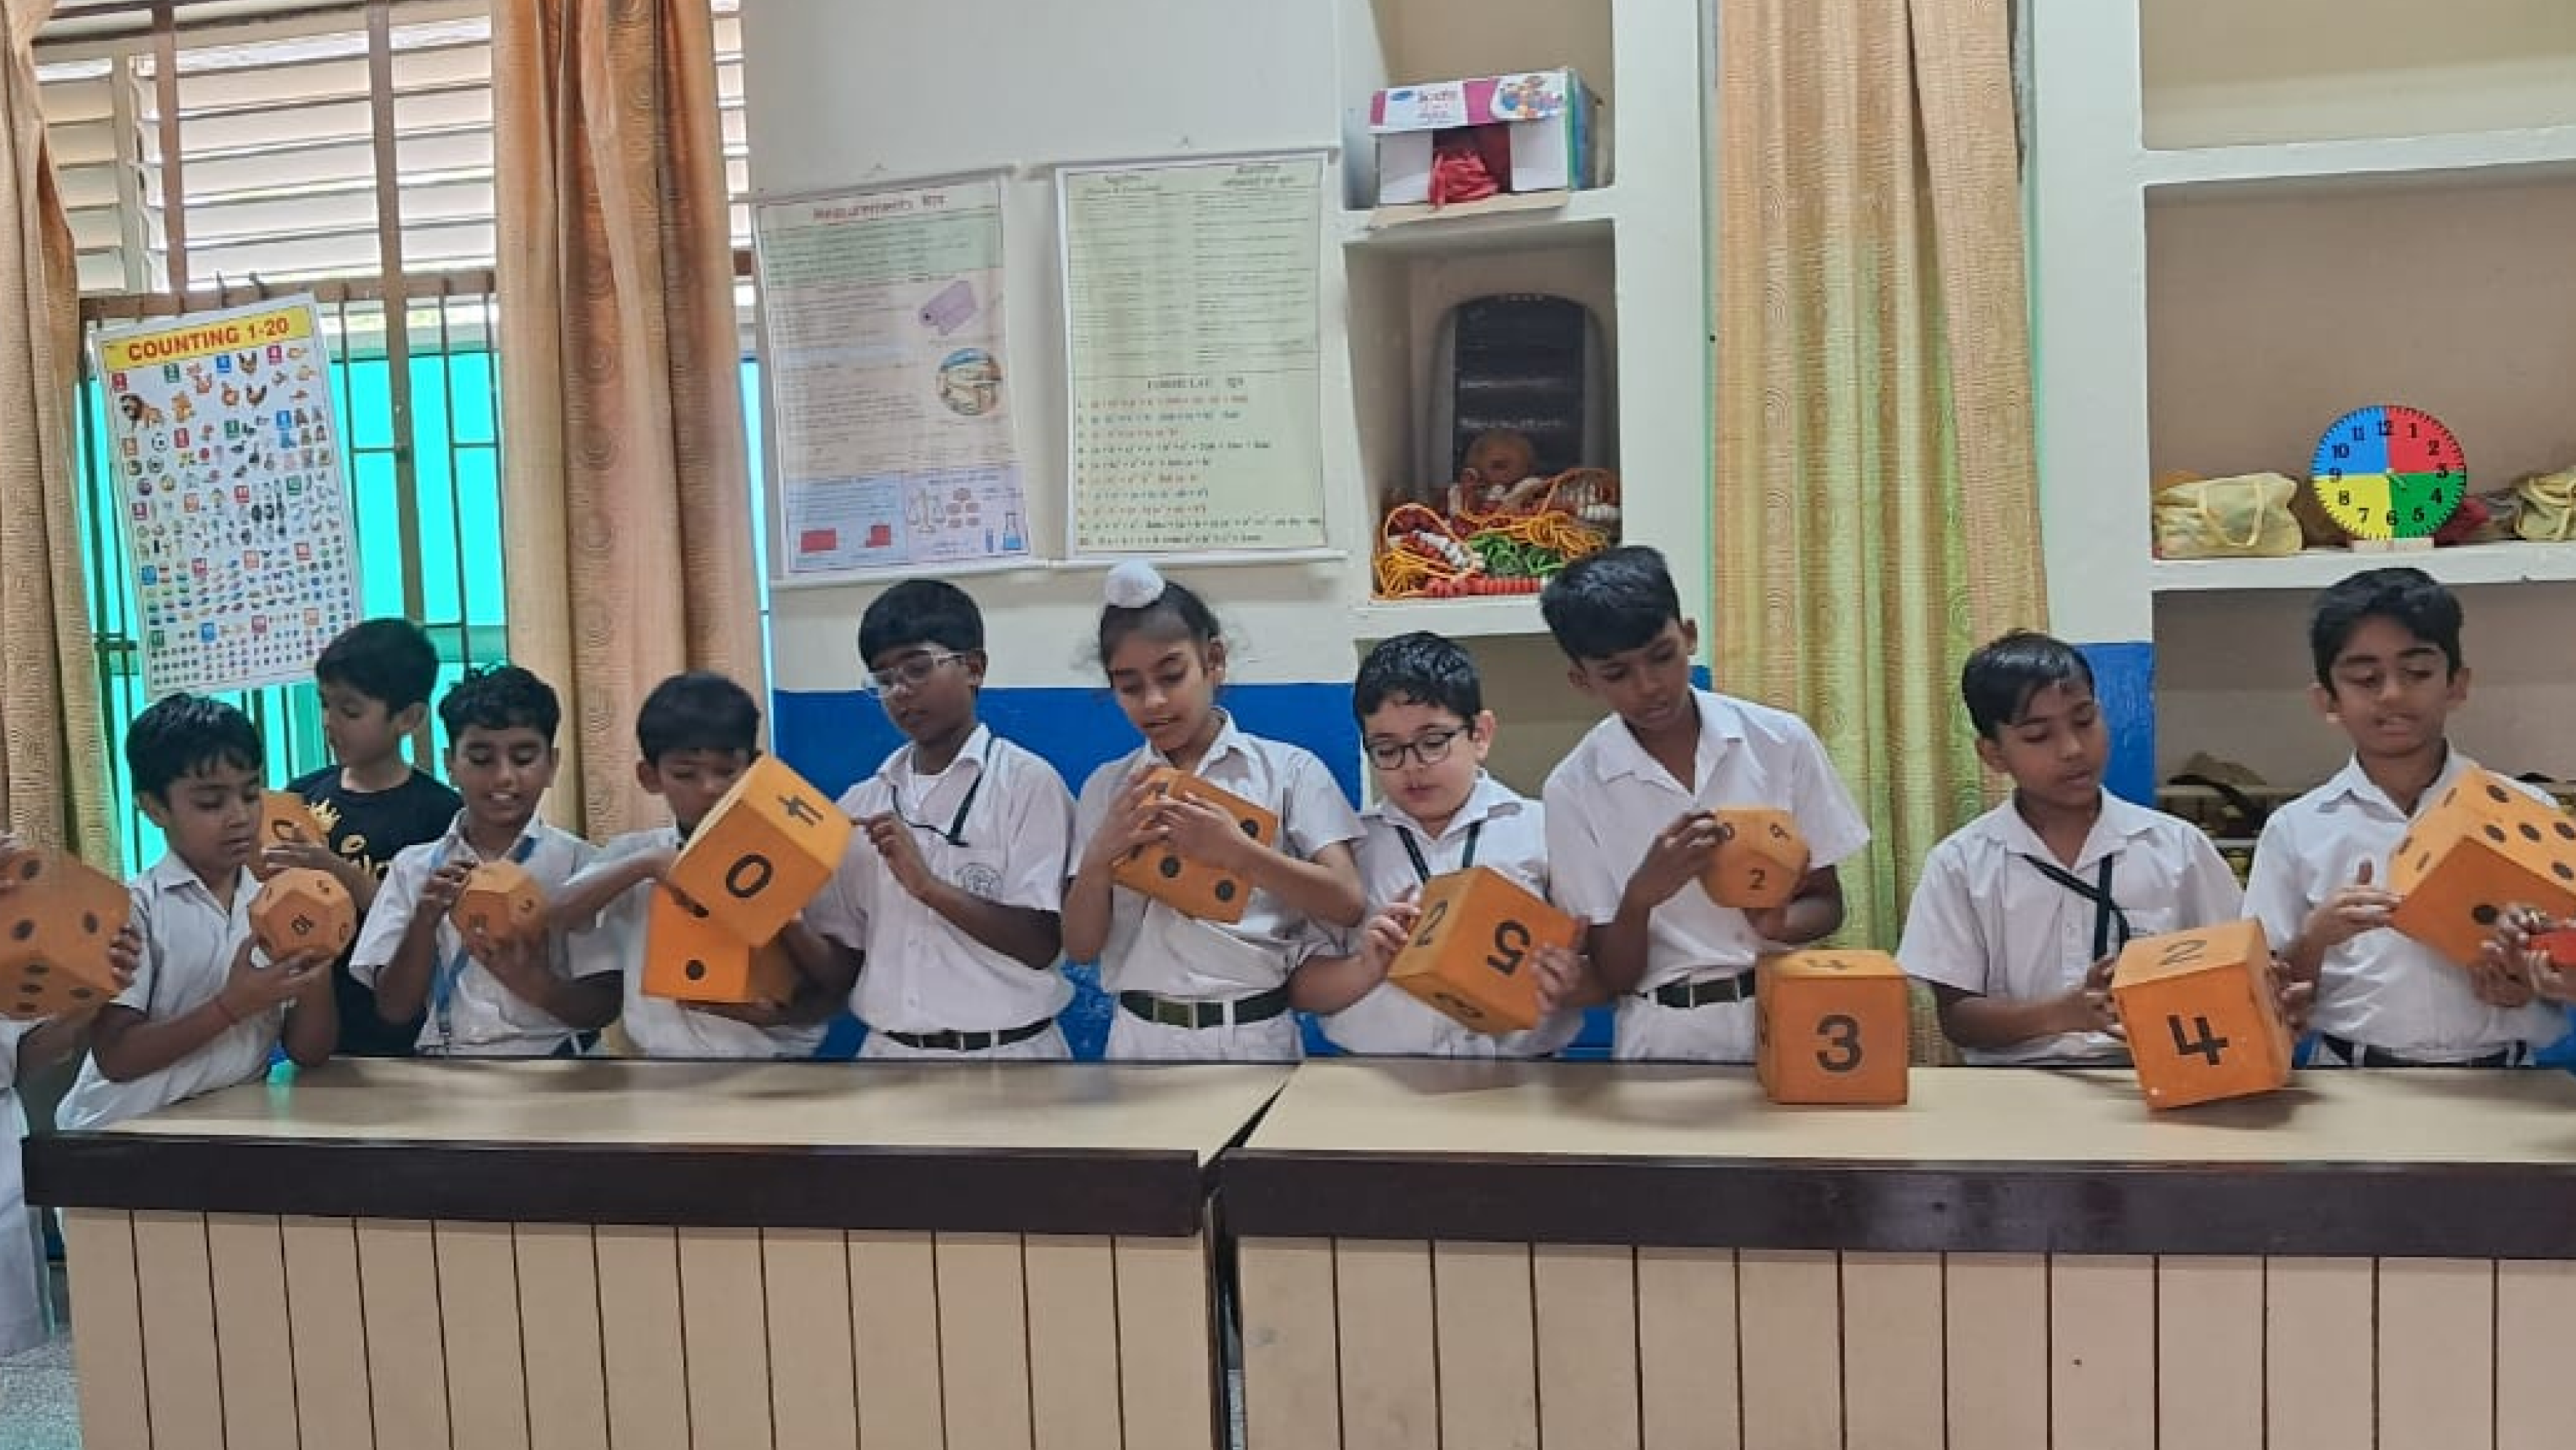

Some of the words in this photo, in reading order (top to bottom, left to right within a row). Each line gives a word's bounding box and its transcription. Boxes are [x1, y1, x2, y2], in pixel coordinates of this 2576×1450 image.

[128, 325, 239, 361] COUNTING
[247, 317, 290, 338] 1-20
[2351, 426, 2366, 441] 11
[2377, 420, 2394, 436] 12
[2409, 422, 2418, 438] 1
[2331, 443, 2350, 459] 10
[2426, 440, 2440, 456] 2
[2328, 467, 2342, 483] 9
[2436, 462, 2449, 479] 3
[2338, 490, 2350, 506] 8
[2429, 487, 2442, 504] 4
[2357, 507, 2369, 523] 7
[2386, 509, 2398, 526] 6
[2412, 507, 2425, 523] 5
[778, 795, 824, 827] 4
[725, 854, 774, 899] 0
[1749, 868, 1766, 890] 2
[1415, 899, 1449, 948] 2
[1487, 919, 1531, 976] 5
[2158, 939, 2208, 965] 2
[1816, 1014, 1863, 1072] 3
[2166, 1014, 2230, 1066] 4
